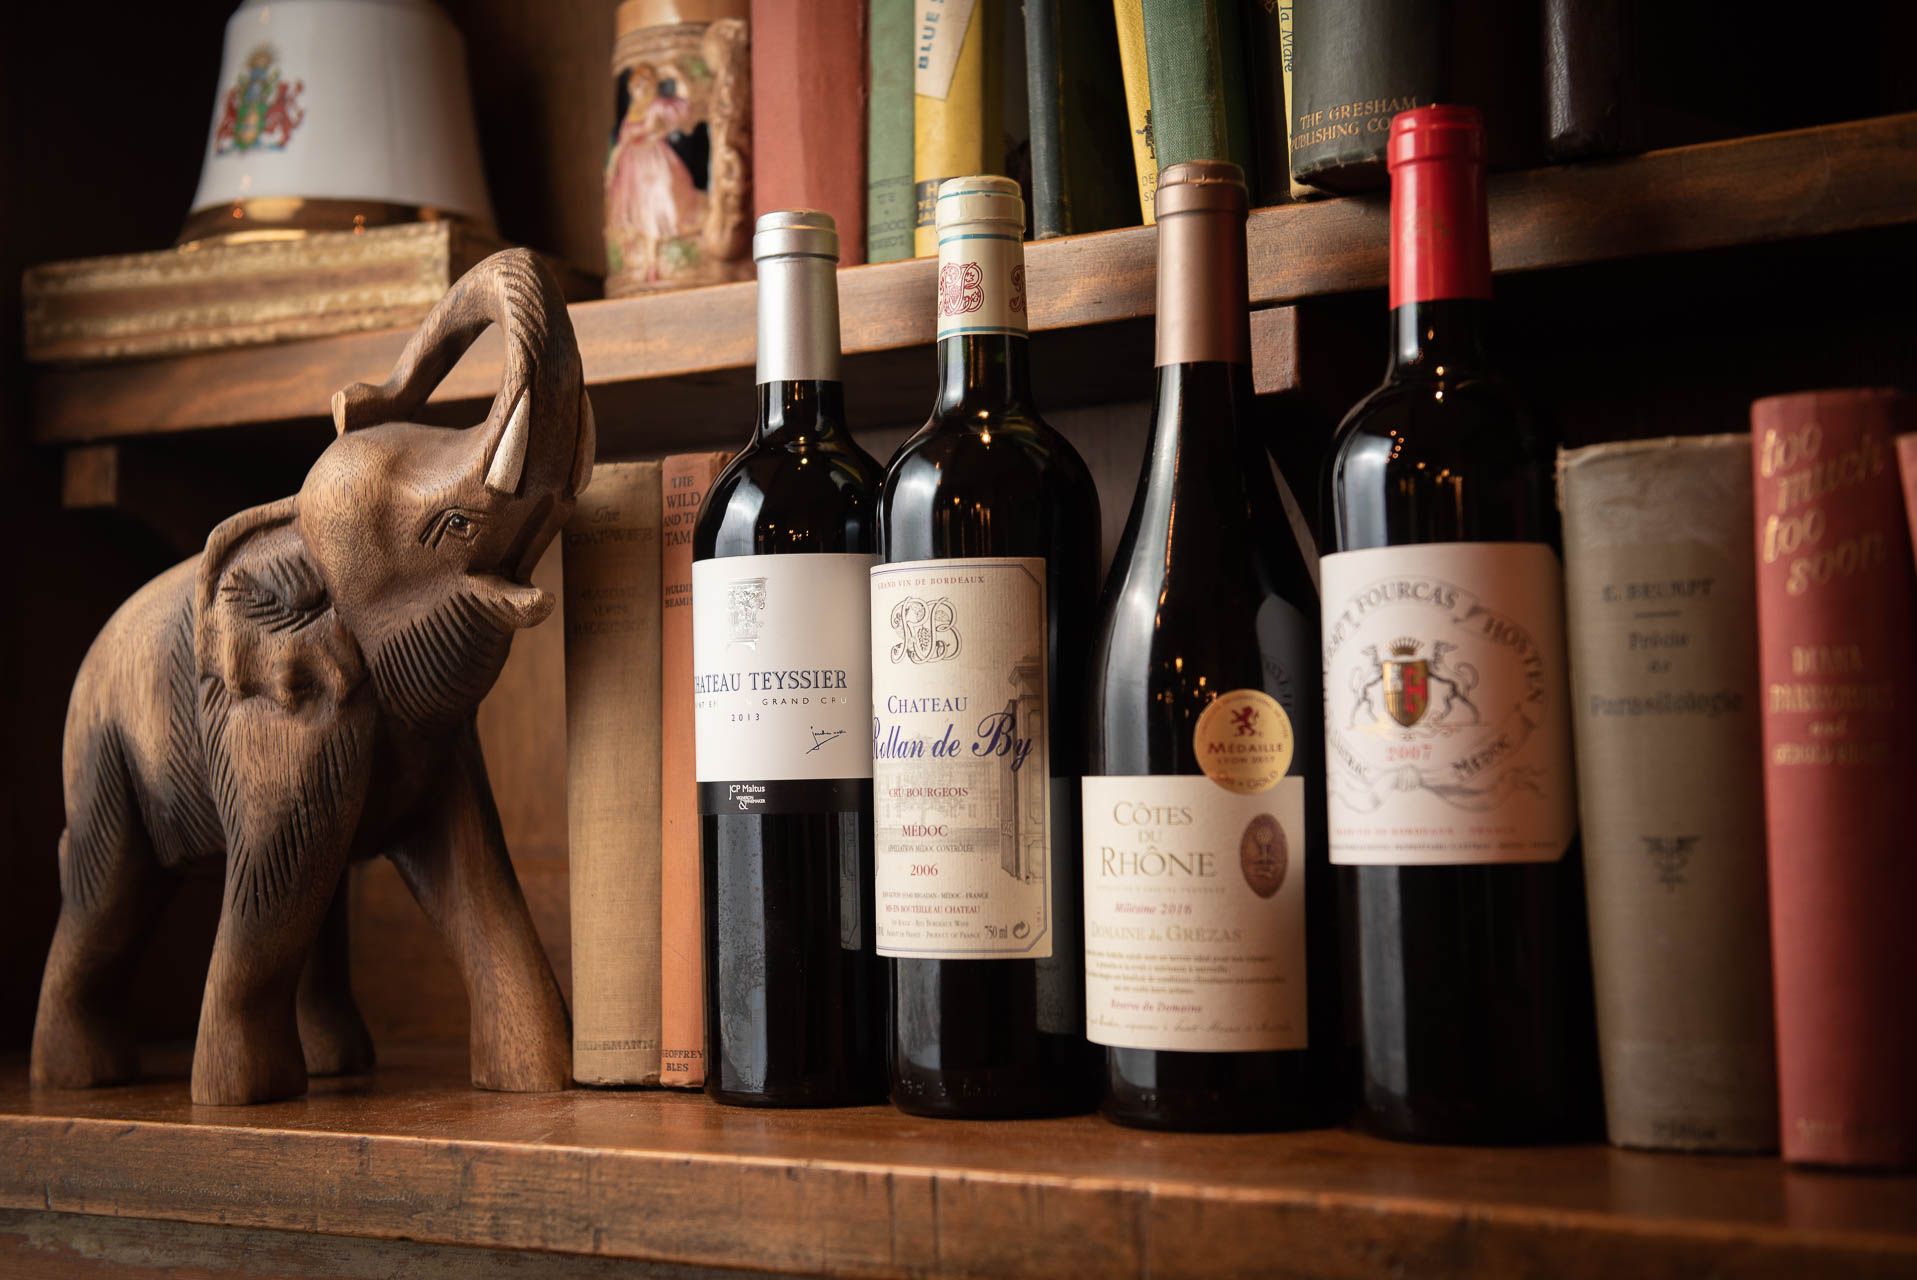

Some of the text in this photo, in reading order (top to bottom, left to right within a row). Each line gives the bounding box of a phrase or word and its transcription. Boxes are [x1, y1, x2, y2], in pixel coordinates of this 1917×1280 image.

[1280, 7, 1294, 22] la
[918, 12, 940, 69] BLUE
[1300, 96, 1416, 130] THE GRESHAM
[1290, 121, 1360, 152] PUBLISHING
[1762, 422, 1823, 477] too
[672, 475, 694, 489] THE
[1777, 442, 1885, 514] much
[666, 492, 701, 509] WILD
[664, 512, 696, 527] AND TH
[665, 531, 691, 546] TAM
[1763, 507, 1826, 563] too
[1786, 531, 1887, 597] soon
[899, 579, 912, 588] VIN
[915, 577, 926, 586] DE
[930, 576, 985, 585] BORDEAUX
[1358, 580, 1460, 614] FOURCAS
[748, 669, 848, 692] TEYSSIER
[762, 696, 847, 706] GRAND CRU
[887, 695, 968, 714] CHATEAU
[731, 713, 761, 722] 2013
[931, 723, 961, 758] de
[971, 712, 1033, 772] By
[742, 784, 765, 793] Maltus
[888, 787, 969, 797] CRU BOURGEOIS
[1113, 801, 1193, 826] CÔTES
[1137, 830, 1163, 844] DU
[910, 864, 938, 876] 2006
[1099, 845, 1217, 878] RHÔNE
[933, 905, 943, 913] AU
[944, 905, 981, 914] CHATEAU
[666, 1063, 689, 1072] BLES
